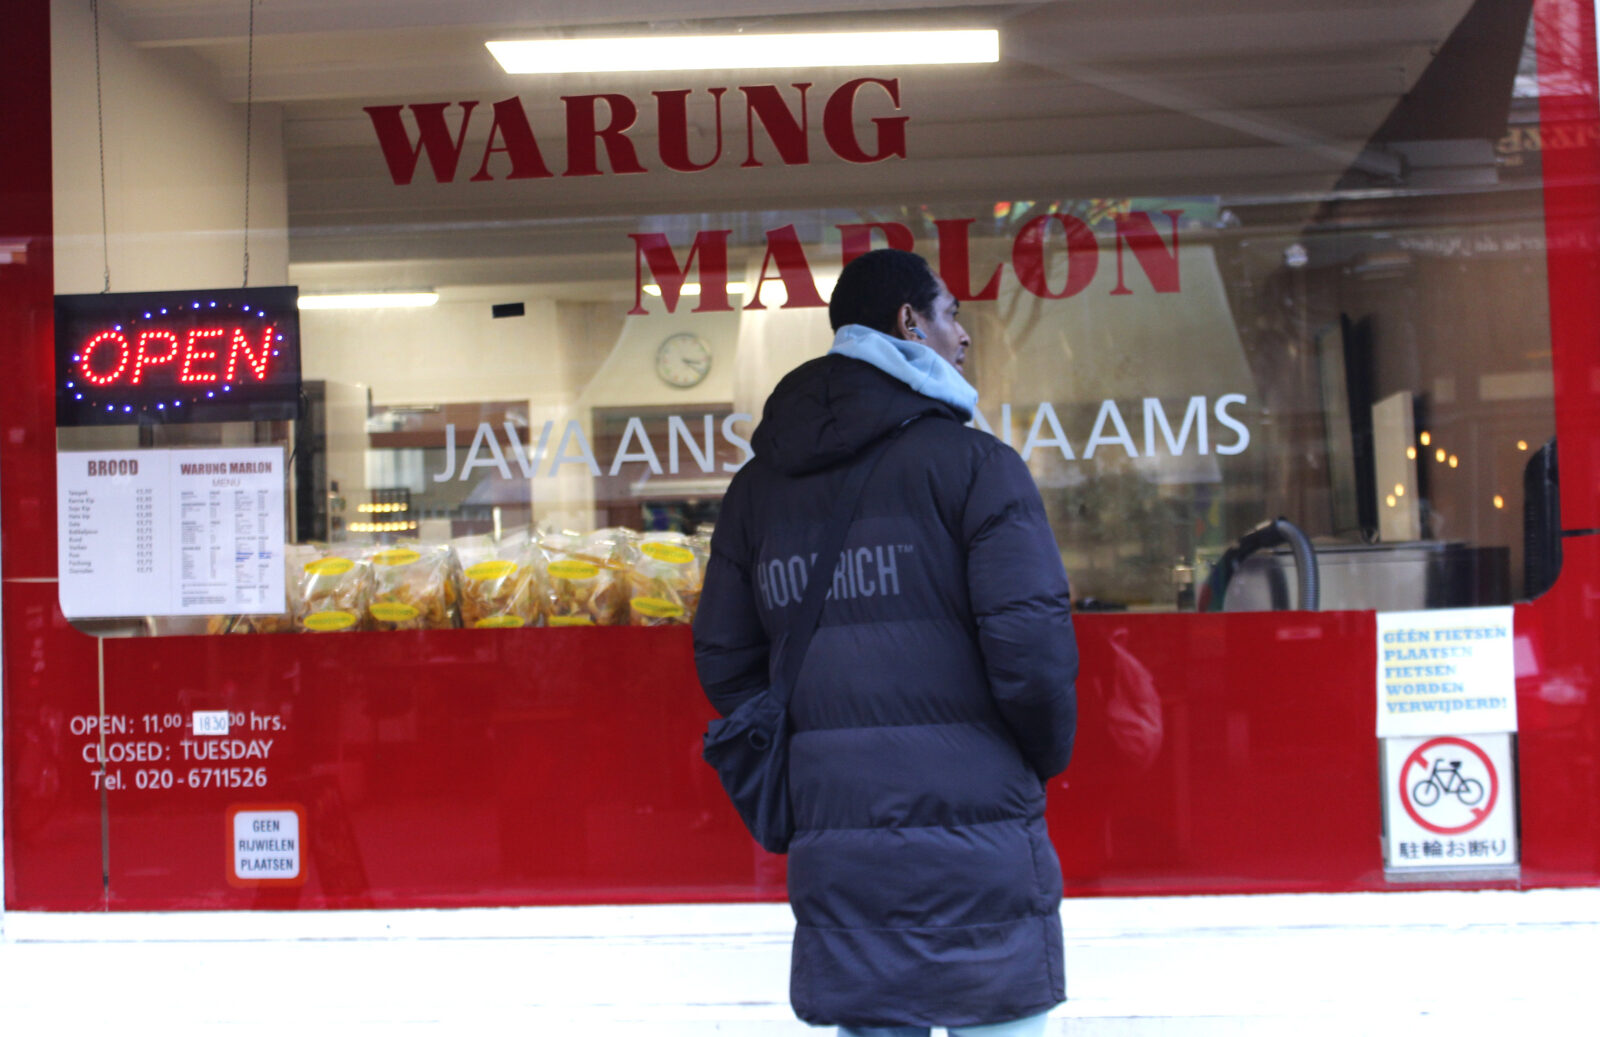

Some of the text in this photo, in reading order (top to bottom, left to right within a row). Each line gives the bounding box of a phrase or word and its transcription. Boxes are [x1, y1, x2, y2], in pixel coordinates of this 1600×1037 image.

[364, 78, 909, 186] WARUNG
[82, 328, 273, 384] OPEN
[433, 413, 757, 483] JAVAANS
[88, 459, 139, 476] BROOD
[180, 461, 273, 475] WARUNG MARLON
[757, 545, 900, 610] HOORICH
[1383, 627, 1507, 643] GÉÉN FIETSEN
[1384, 646, 1473, 661] PLAATSEN
[1385, 665, 1457, 678] FIETSEN
[1386, 682, 1464, 695] WORDEN
[1386, 697, 1507, 713] VERWIJDERD!
[251, 711, 287, 731] hrs.
[180, 739, 274, 761] TUESDAY
[91, 770, 126, 790] Tel.
[253, 820, 280, 832] GEEN
[239, 840, 294, 852] RIJWIELEN
[241, 859, 293, 871] PLAATSEN
